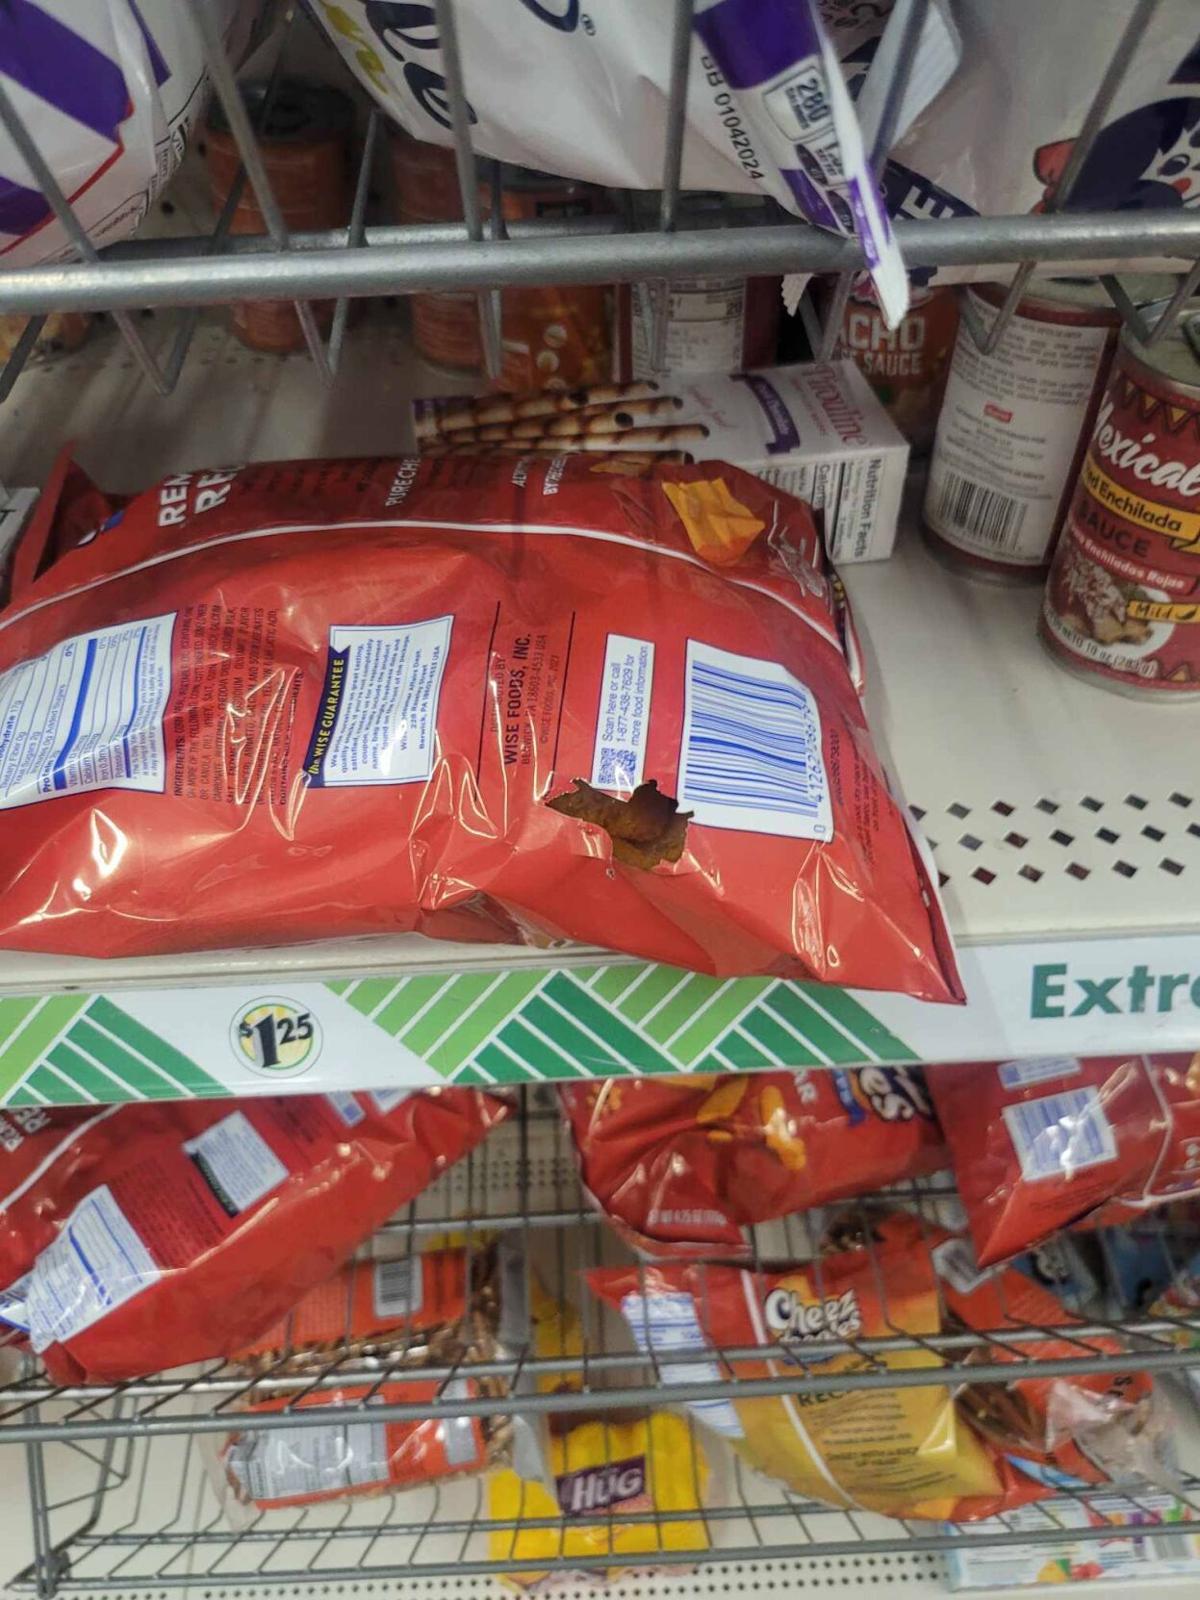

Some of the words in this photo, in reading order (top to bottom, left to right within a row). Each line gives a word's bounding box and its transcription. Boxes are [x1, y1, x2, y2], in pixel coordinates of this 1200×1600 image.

[800, 77, 830, 123] 280
[714, 92, 765, 180] 01042024
[843, 313, 925, 352] CHO
[863, 352, 922, 376] SAUCE
[862, 459, 884, 521] Nutrition
[1099, 482, 1182, 533] Enchilada
[854, 519, 873, 557] Facts
[1136, 603, 1174, 620] Mild
[513, 631, 531, 661] INC.
[536, 633, 546, 651] USA
[497, 657, 506, 670] BY
[610, 662, 620, 679] call
[624, 654, 634, 667] for
[635, 645, 649, 694] information
[322, 659, 345, 728] GUARANTEE
[507, 664, 526, 719] FOODS,
[610, 681, 618, 691] or
[606, 693, 618, 714] here
[616, 668, 633, 743] 1-877-438-7629
[633, 696, 644, 718] food
[313, 729, 332, 759] WISE
[504, 722, 519, 766] WISE
[603, 716, 615, 742] Scan
[630, 719, 641, 746] more
[43, 759, 54, 793] Protein
[174, 735, 185, 796] INGREDIENTS:
